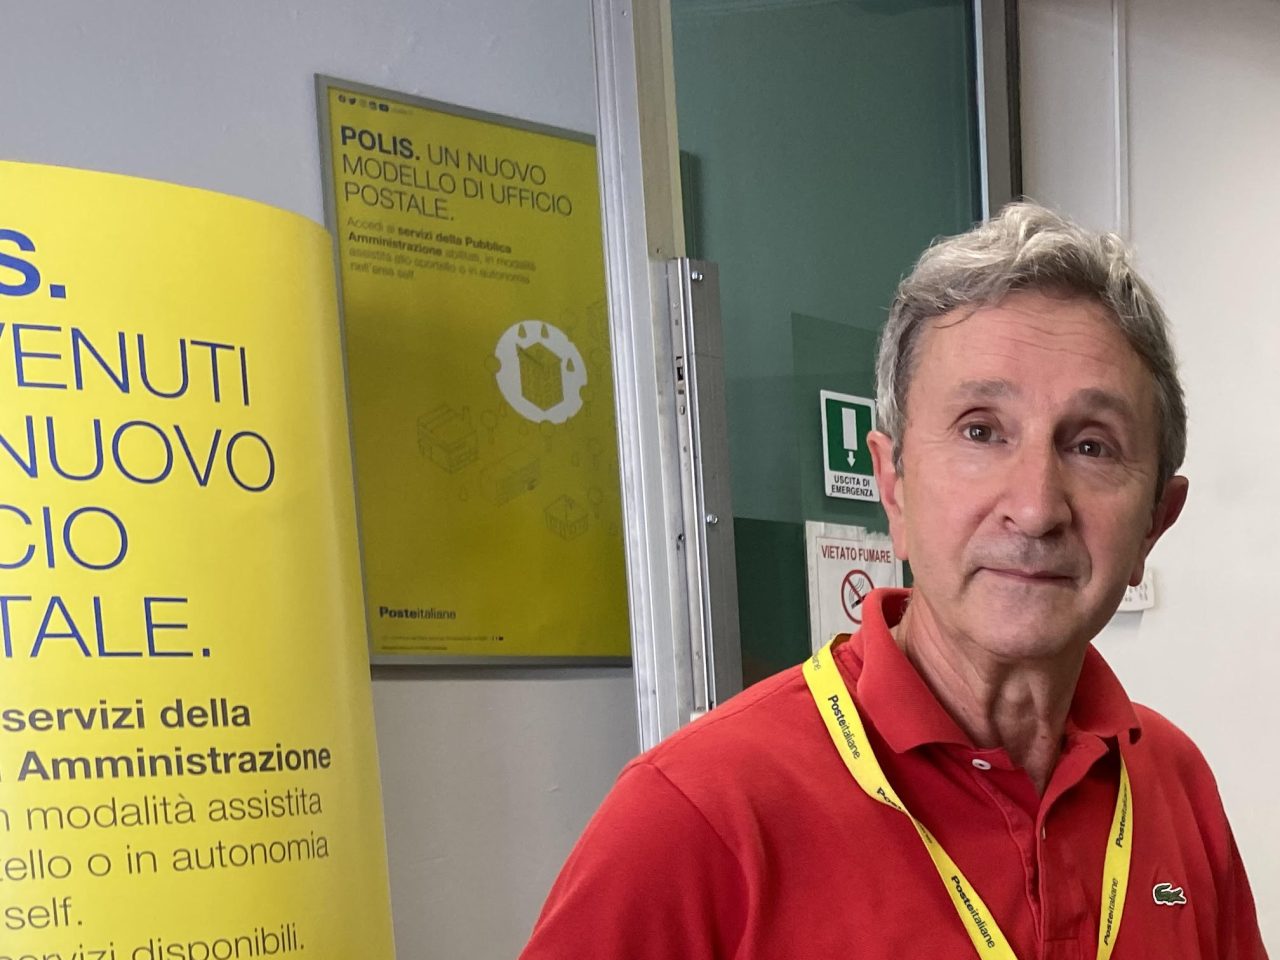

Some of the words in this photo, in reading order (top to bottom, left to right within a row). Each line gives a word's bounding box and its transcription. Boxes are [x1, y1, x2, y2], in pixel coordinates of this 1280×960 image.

[340, 125, 421, 160] POLIS.
[427, 143, 460, 169] UN
[467, 151, 546, 186] NUOVO
[342, 153, 456, 194] MODELLO
[463, 176, 484, 200] DI
[490, 185, 573, 217] UFFICIO
[344, 181, 454, 221] POSTALE.
[348, 231, 443, 256] Amministrazione
[398, 226, 433, 241] servizi
[435, 232, 462, 246] della
[465, 236, 512, 254] Pubblica
[0, 322, 250, 406] ENUTI
[831, 484, 874, 498] EMERGENZA
[833, 474, 862, 487] USCITA
[863, 477, 871, 488] DI
[821, 545, 857, 561] VIETATO
[858, 548, 891, 564] FUMARE
[379, 606, 456, 620] Posteitaliane
[2, 699, 145, 732] servizi
[160, 698, 252, 729] della
[828, 695, 861, 760] Posteitaliane
[17, 743, 331, 782] Amministrazione
[26, 793, 196, 831] modalità
[208, 787, 322, 823] assistita
[0, 849, 72, 881] ello
[88, 853, 112, 877] o
[126, 845, 158, 875] in
[172, 830, 329, 872] autonomia
[4, 896, 83, 931] self.
[951, 875, 996, 949] Posteitaliane
[1104, 878, 1118, 946] Posteitaliane
